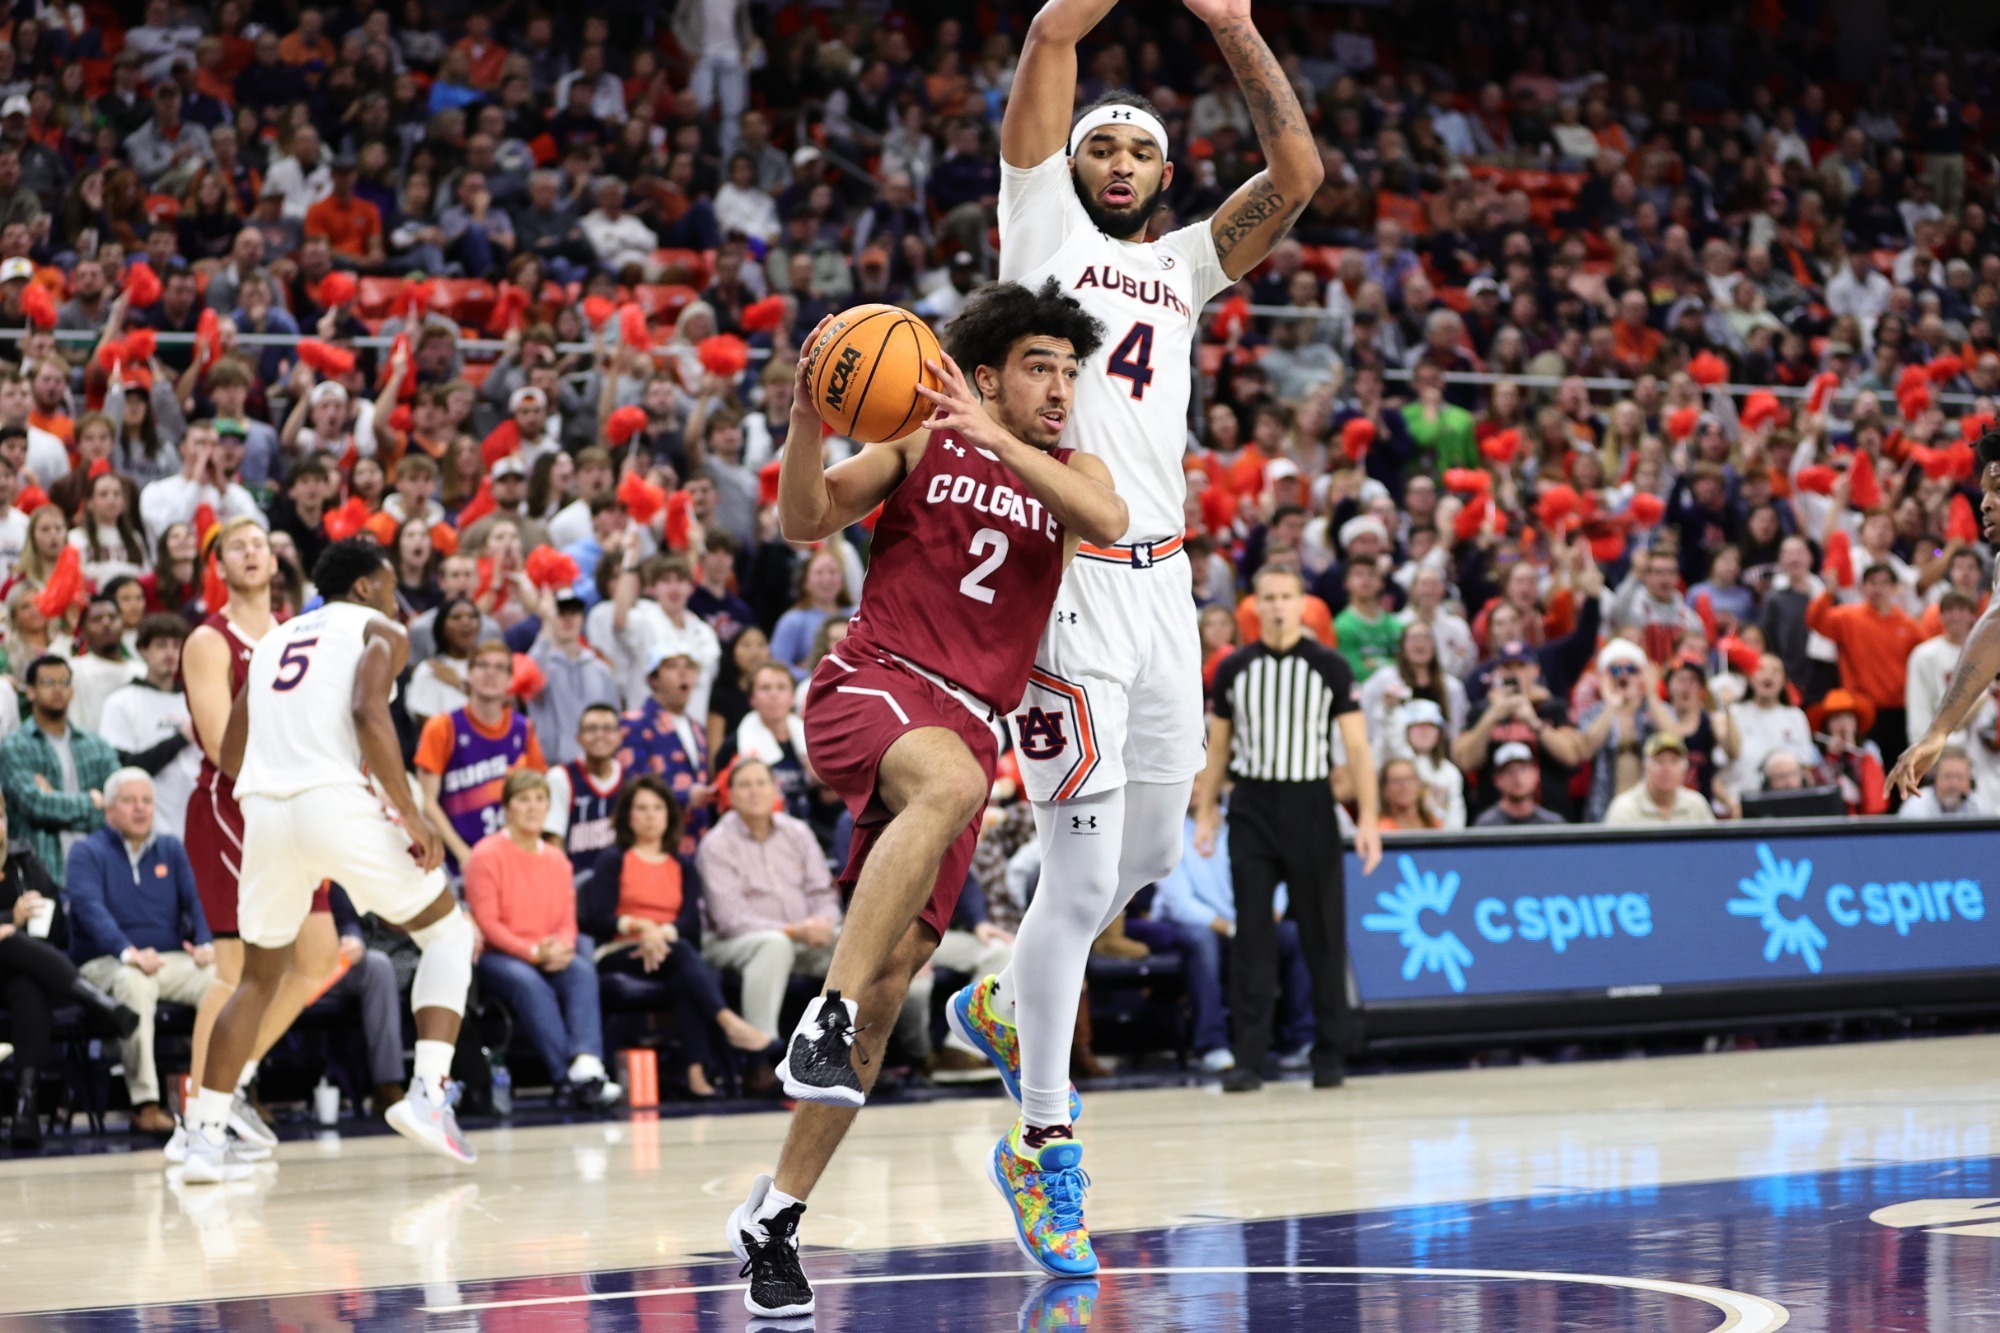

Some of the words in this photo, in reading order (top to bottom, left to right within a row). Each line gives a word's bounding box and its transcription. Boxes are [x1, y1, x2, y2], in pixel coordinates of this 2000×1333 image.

[1215, 193, 1285, 259] LESSED
[825, 346, 862, 412] NCAA
[1106, 320, 1155, 402] 4
[926, 474, 1058, 543] COLGATE
[959, 527, 1010, 605] 2
[270, 636, 319, 692] 5
